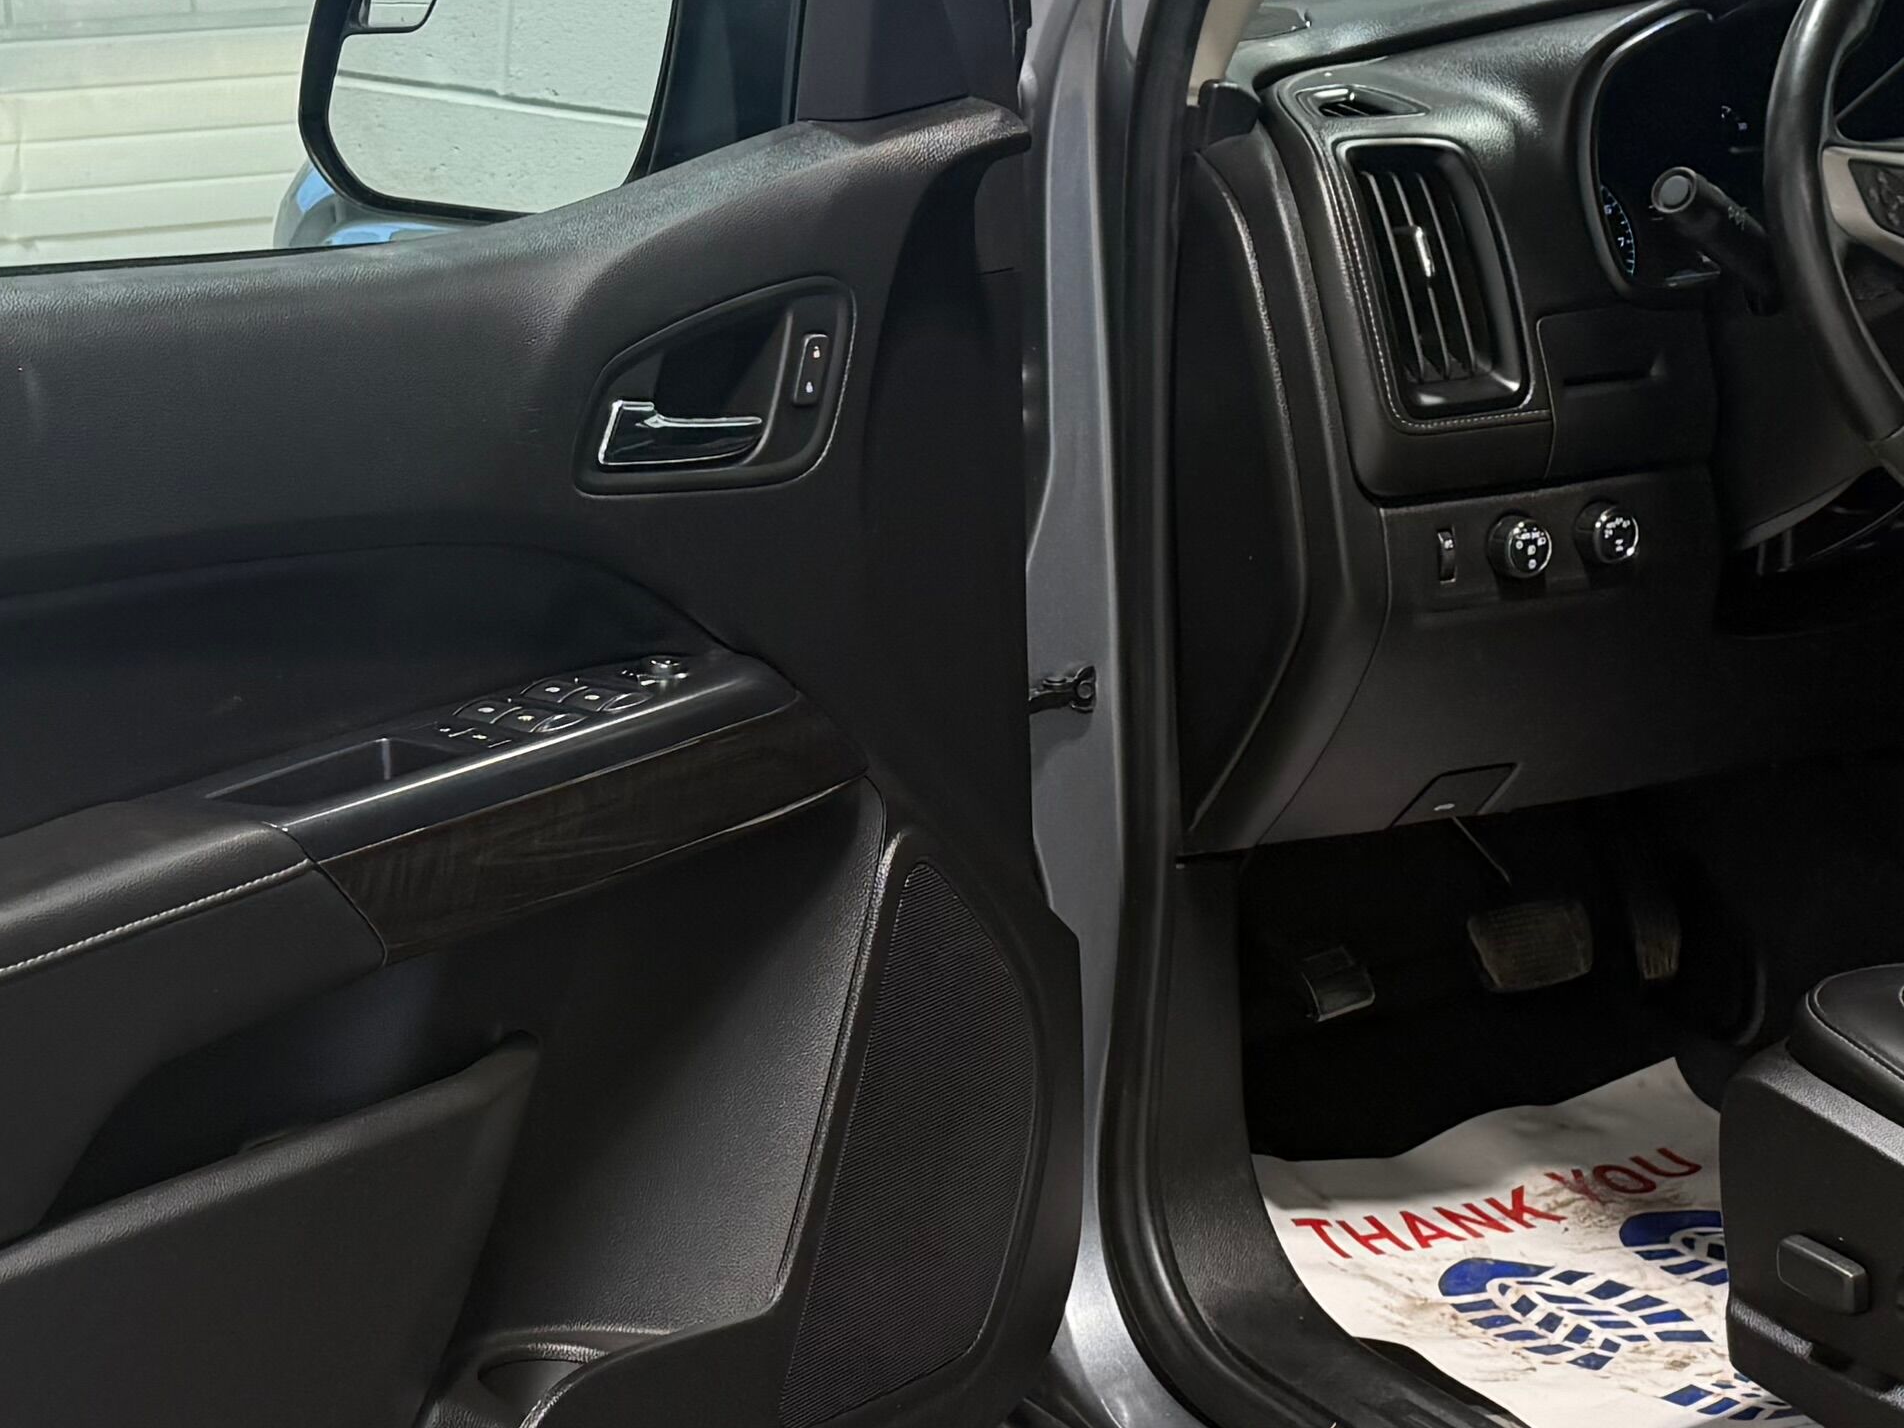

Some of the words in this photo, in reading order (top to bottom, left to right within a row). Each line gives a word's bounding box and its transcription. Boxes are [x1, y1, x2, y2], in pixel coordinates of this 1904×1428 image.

[1617, 236, 1626, 248] 7
[1290, 1185, 1568, 1259] THANK
[1544, 1147, 1703, 1204] YOU
